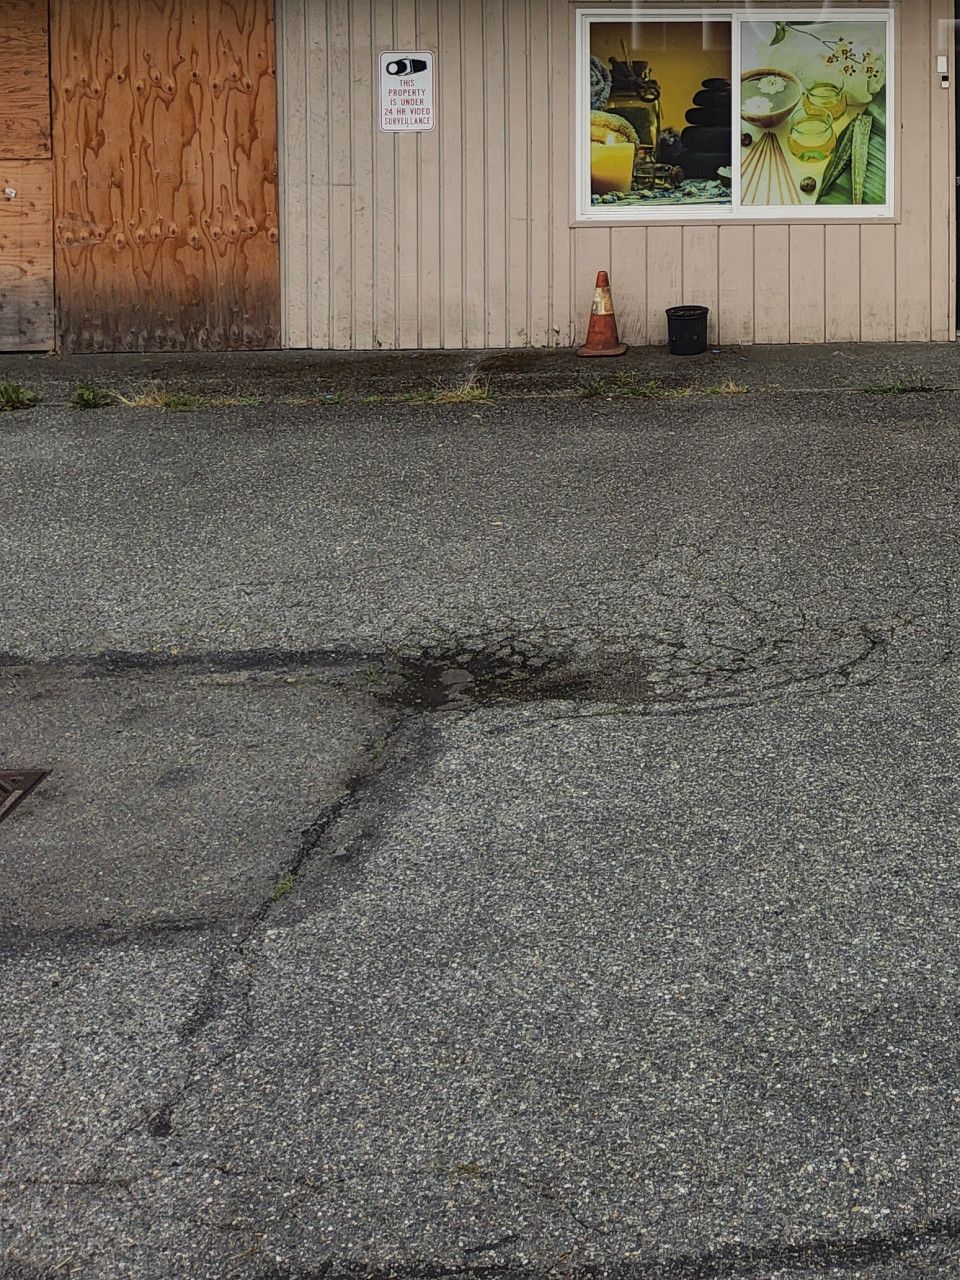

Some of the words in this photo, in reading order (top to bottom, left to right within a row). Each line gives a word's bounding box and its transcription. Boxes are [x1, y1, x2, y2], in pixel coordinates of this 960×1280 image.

[400, 79, 415, 87] THIS
[384, 108, 393, 116] 24
[396, 108, 406, 116] HR
[410, 108, 431, 116] VIDEO
[384, 117, 431, 125] SURVEILLANCE
